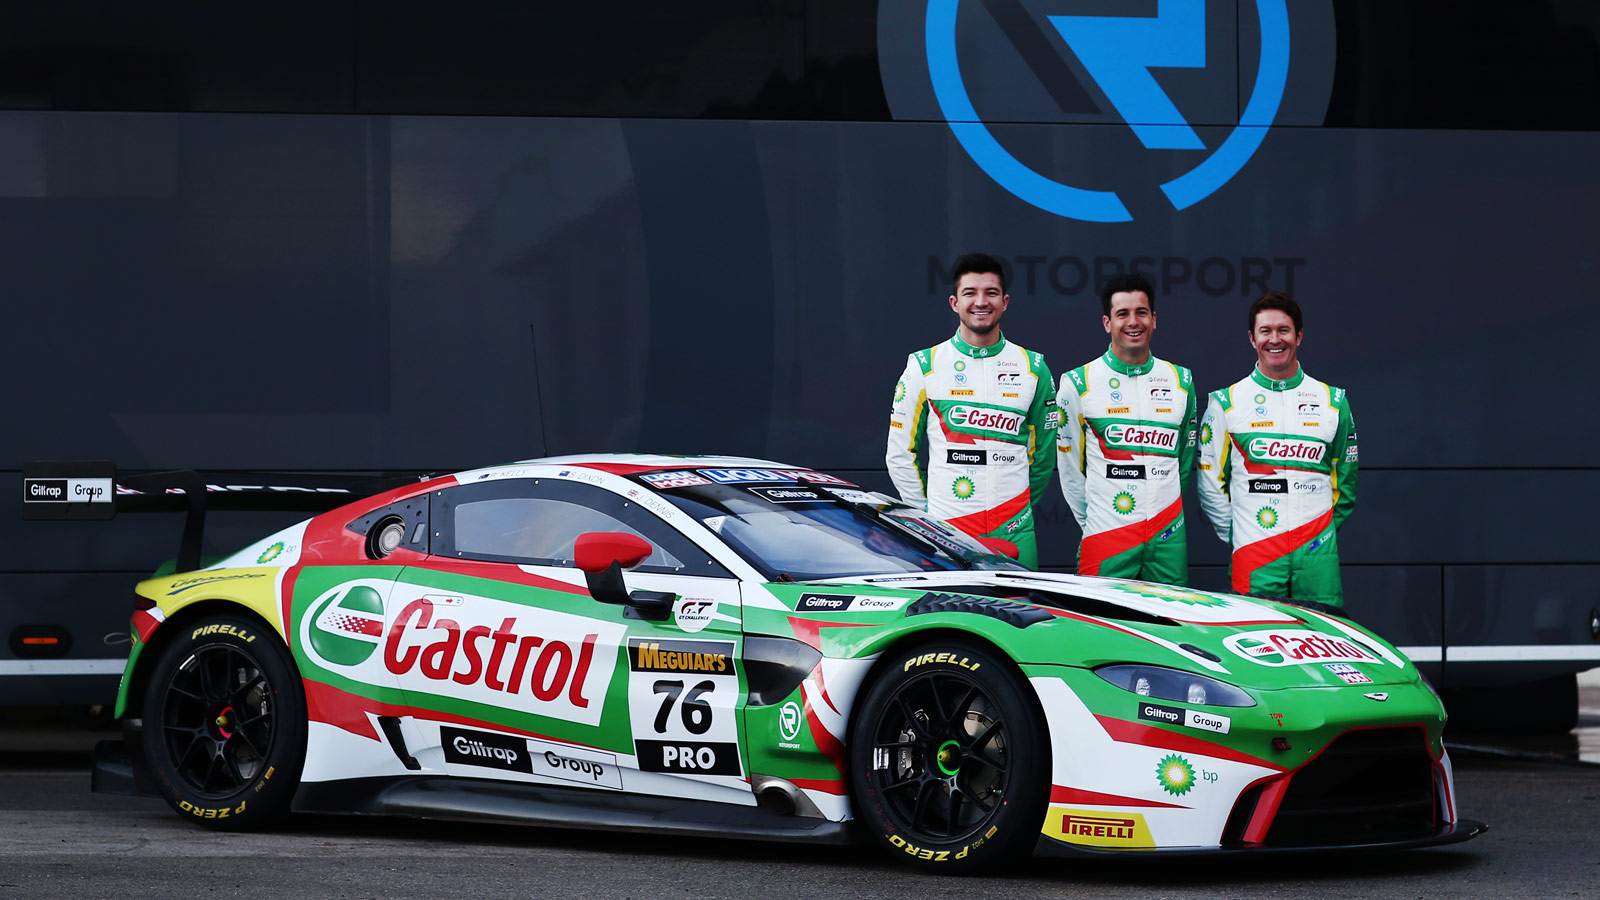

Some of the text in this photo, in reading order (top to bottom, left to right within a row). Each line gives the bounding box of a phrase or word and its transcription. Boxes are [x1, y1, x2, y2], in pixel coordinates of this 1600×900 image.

[926, 254, 1306, 298] MTORSPORT
[967, 410, 1020, 432] Castrol
[1124, 427, 1175, 448] Castrol
[951, 453, 1015, 463] Giltrap Group
[1268, 441, 1323, 460] Castrol
[500, 469, 529, 477] KELLY
[578, 472, 606, 485] DIXON
[641, 471, 693, 481] LIQUI
[703, 470, 783, 482] LIQUI
[966, 467, 977, 475] bp
[1111, 467, 1170, 477] Giltrap Group
[31, 484, 62, 498] Giltrap
[74, 484, 103, 499] Group
[656, 477, 710, 488] MOLY
[1254, 481, 1317, 491] Giltrap Group
[644, 496, 675, 519] DENNIS
[805, 597, 894, 609] Giltrap Group
[192, 624, 256, 643] PIRELLI
[384, 598, 599, 708] Castrol
[1269, 634, 1375, 660] Castrol
[904, 652, 981, 672] PIRELLI
[653, 680, 716, 735] 76
[1144, 706, 1223, 730] Giltrap Group
[453, 736, 604, 780] Giltrap Group
[663, 746, 716, 768] PRO
[1202, 768, 1219, 784] bp
[179, 800, 246, 819] P ZERO
[1061, 815, 1136, 839] PIRELLI
[888, 834, 969, 862] P ZERO
